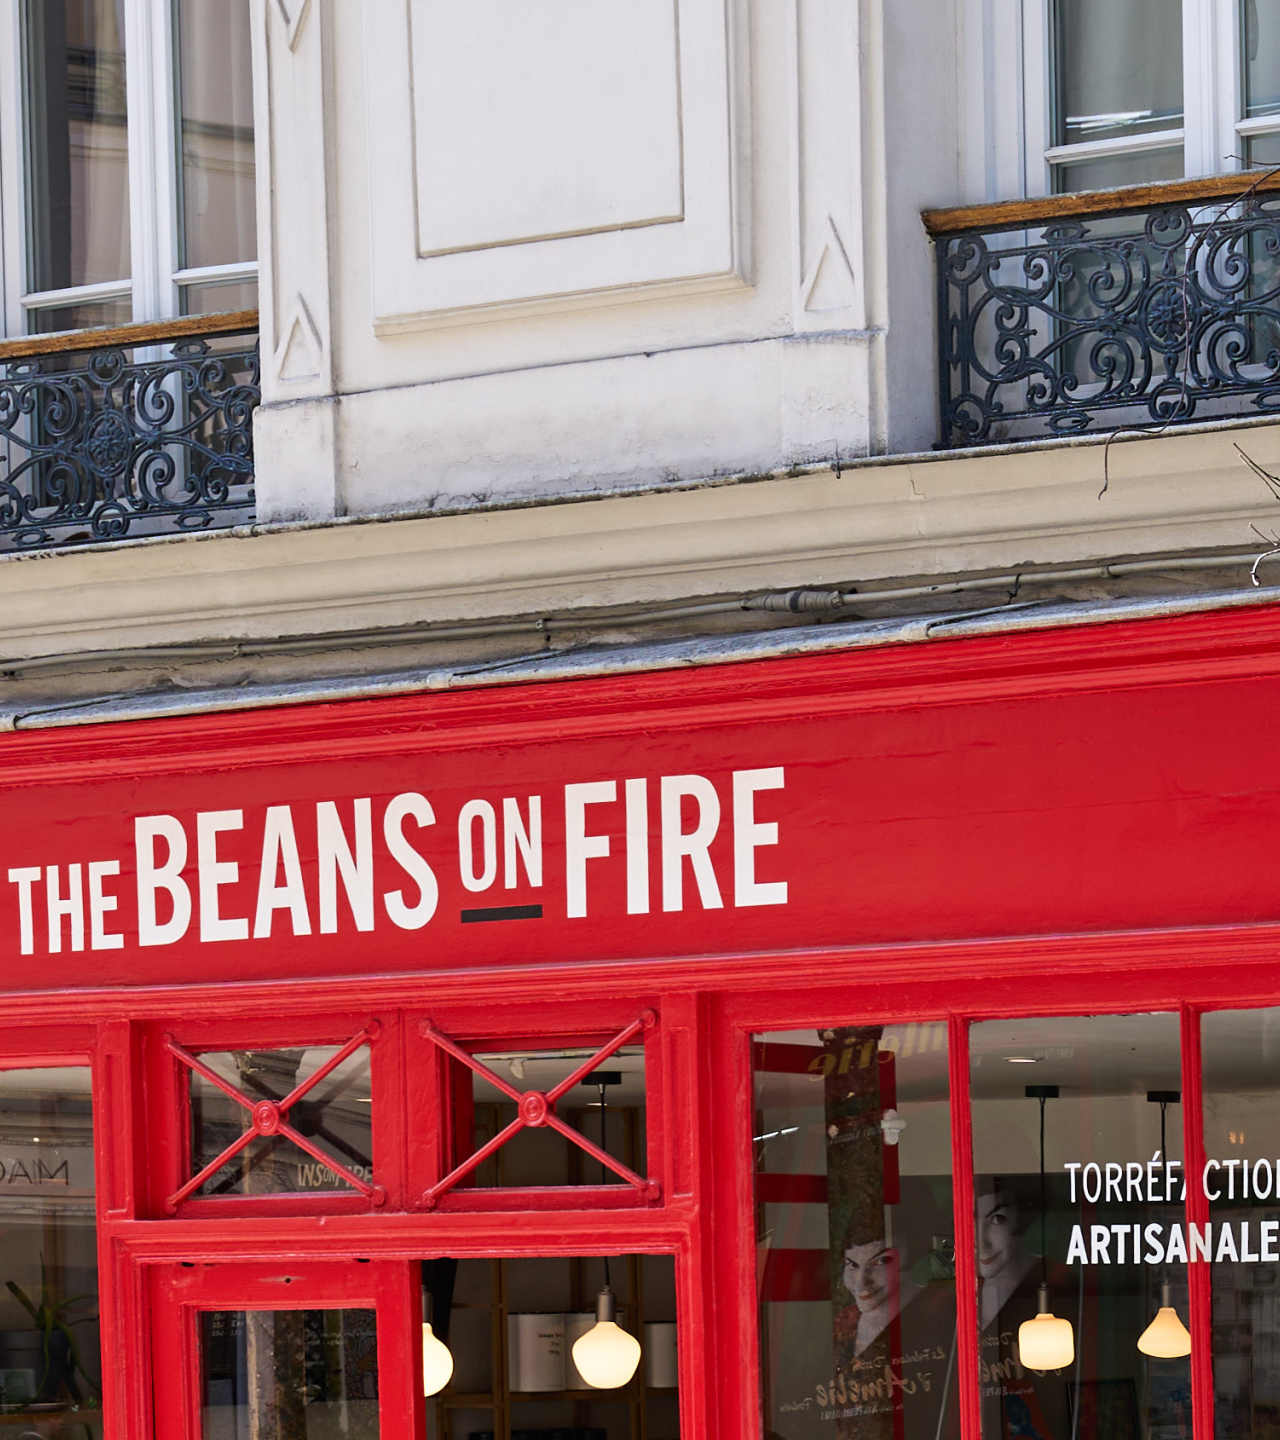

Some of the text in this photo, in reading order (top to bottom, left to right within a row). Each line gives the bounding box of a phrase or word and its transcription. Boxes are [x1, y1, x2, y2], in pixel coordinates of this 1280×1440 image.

[7, 766, 789, 956] THE BEANS ON FIRE
[1066, 1220, 1280, 1265] ARTISANALE
